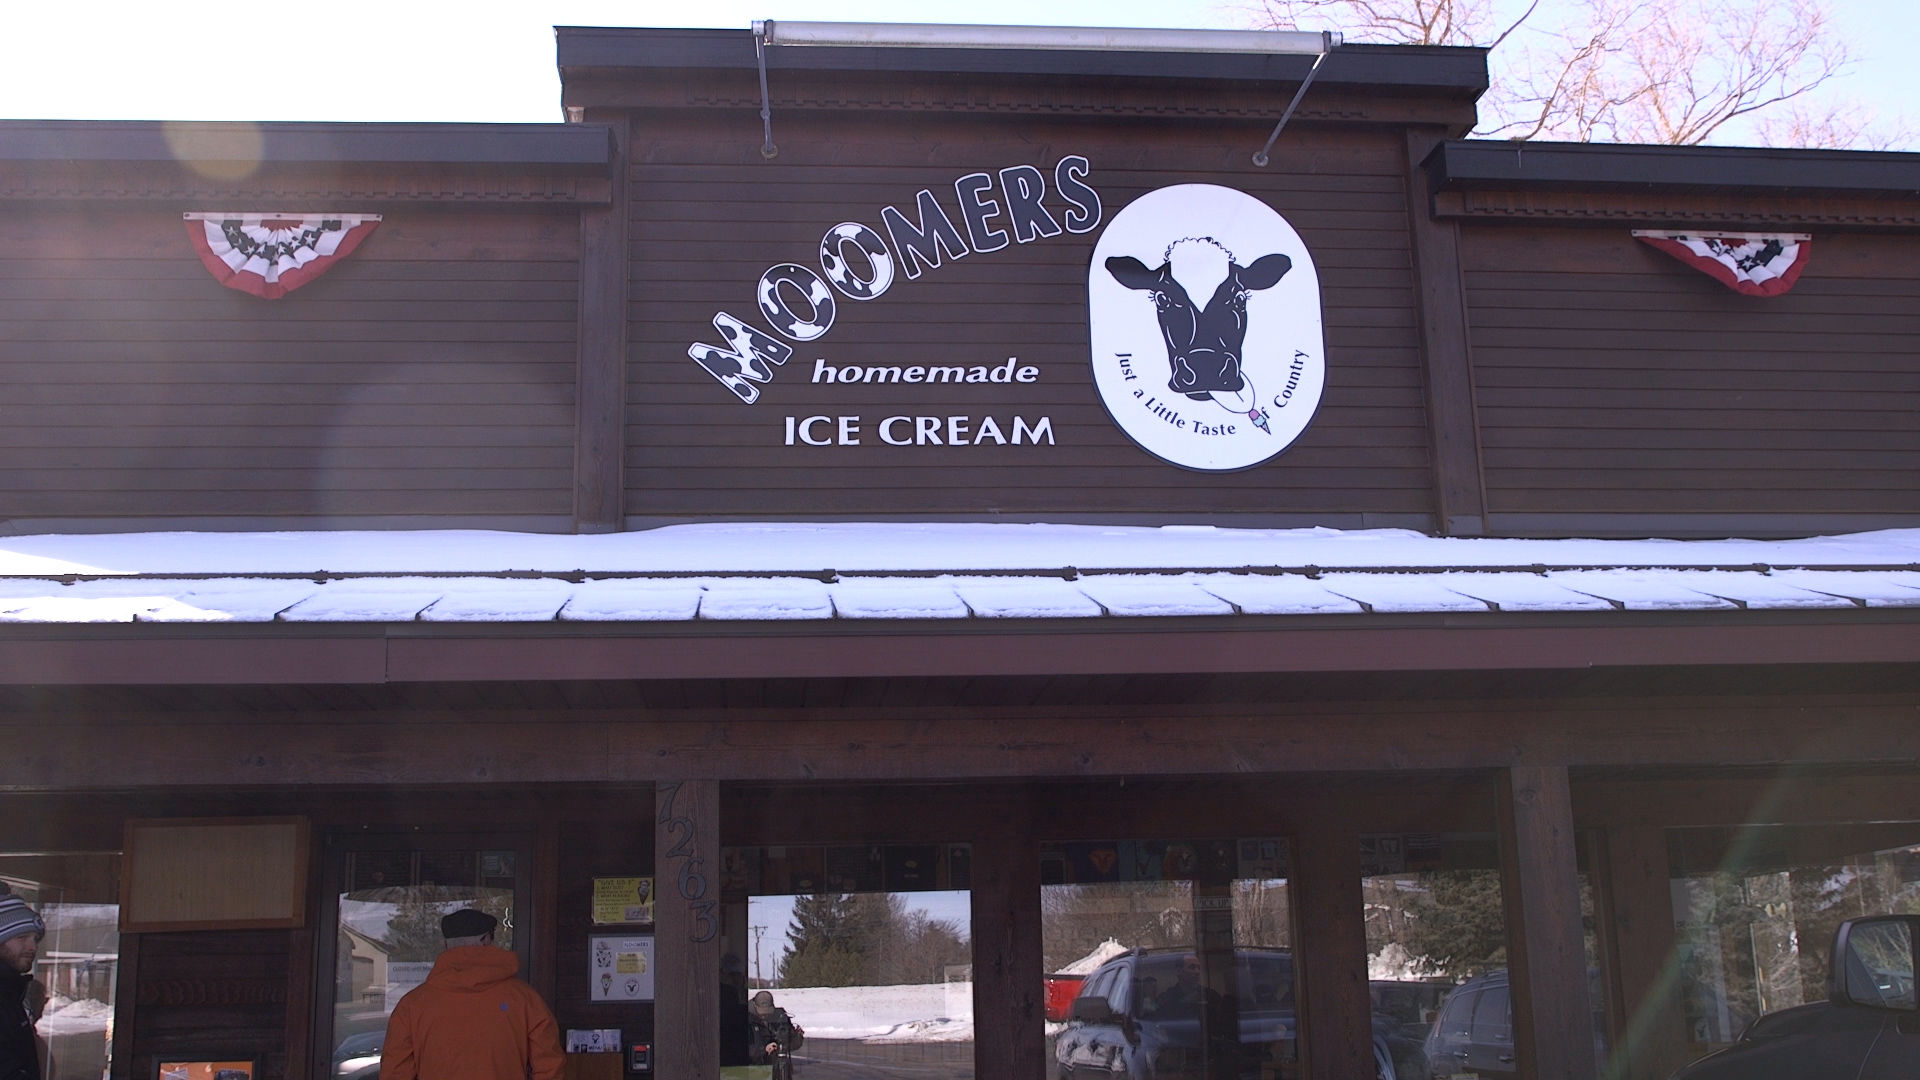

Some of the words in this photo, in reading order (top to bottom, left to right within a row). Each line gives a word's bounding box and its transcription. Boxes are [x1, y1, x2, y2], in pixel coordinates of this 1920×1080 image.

[687, 154, 1102, 405] MOOMERS
[811, 357, 1040, 384] homemade
[1114, 352, 1138, 382] Just
[1133, 388, 1144, 399] a
[1144, 397, 1186, 429] Little
[1192, 420, 1237, 436] Taste
[1273, 349, 1310, 409] Country
[784, 415, 861, 447] ICE
[878, 415, 1056, 446] CREAM
[656, 781, 718, 943] 7263
[1196, 899, 1215, 907] PICK
[1218, 898, 1229, 907] UP
